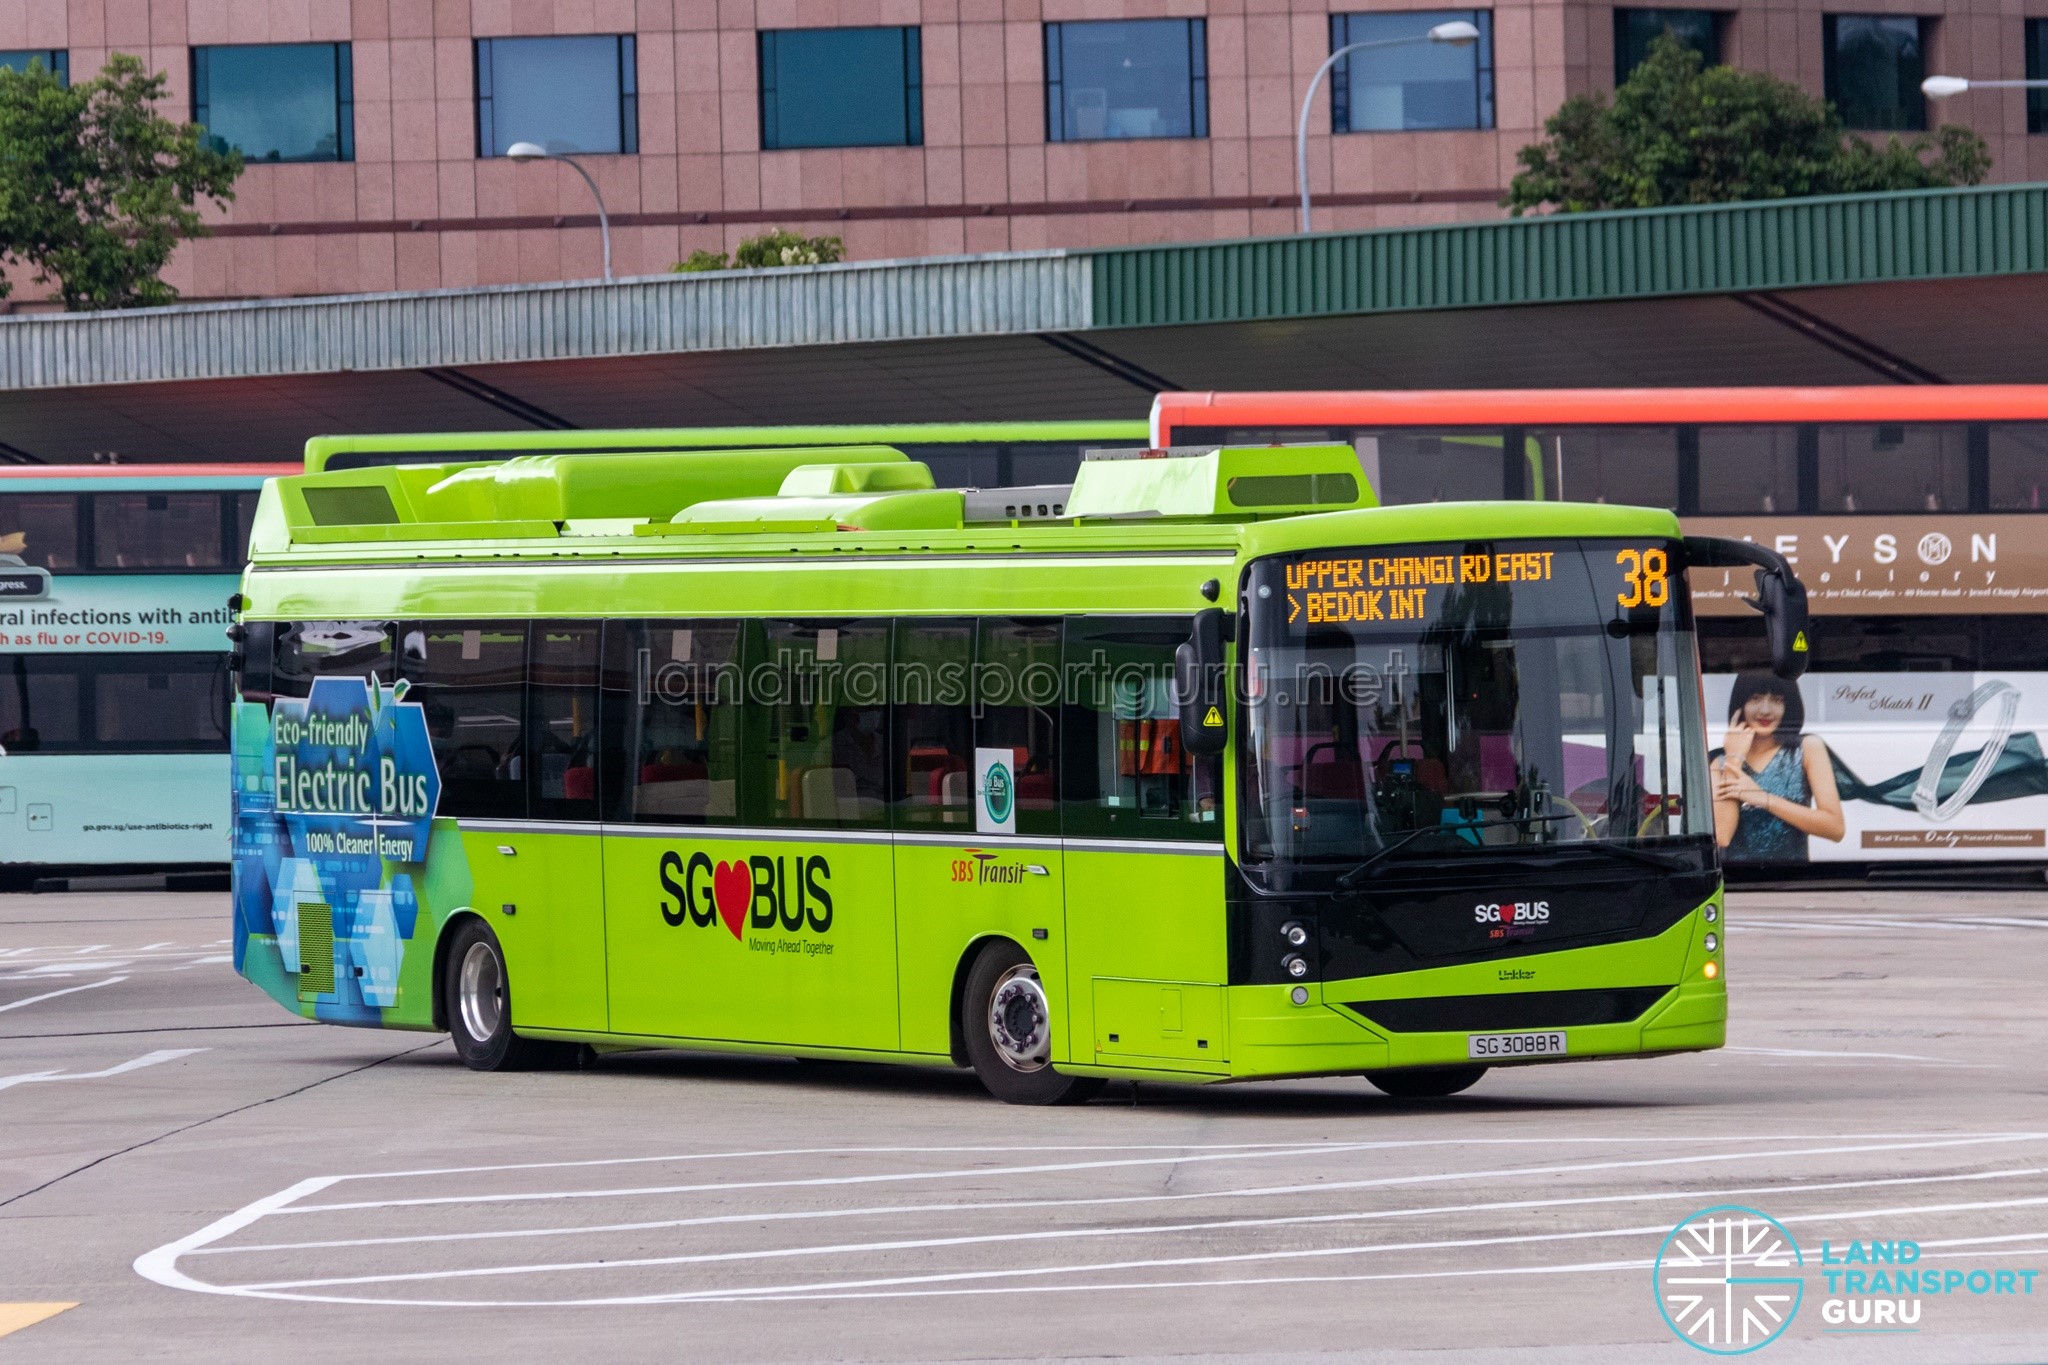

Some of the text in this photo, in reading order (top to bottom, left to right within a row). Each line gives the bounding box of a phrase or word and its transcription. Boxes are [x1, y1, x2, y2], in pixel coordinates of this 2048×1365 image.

[1286, 552, 1554, 590] UPPER CHANGI RD EAST
[1616, 548, 1669, 608] 38
[0, 609, 24, 625] ral
[31, 609, 131, 625] infections
[138, 608, 182, 625] with
[1307, 588, 1427, 623] BEDOK INT
[15, 635, 32, 645] as
[37, 632, 57, 645] flu
[63, 634, 80, 645] or
[86, 631, 168, 645] COVID-19.
[275, 714, 368, 754] Eco-friendly
[275, 755, 428, 815] Electric Bus
[82, 822, 213, 832] go.gov.sg/use-antibiotics-right
[305, 833, 413, 862] 100% Cleaner Energy
[951, 853, 1029, 886] SBS Transit
[749, 938, 834, 958] Moving Ahead Together
[1489, 930, 1504, 938] SBS
[1476, 1035, 1560, 1054] SG3088R
